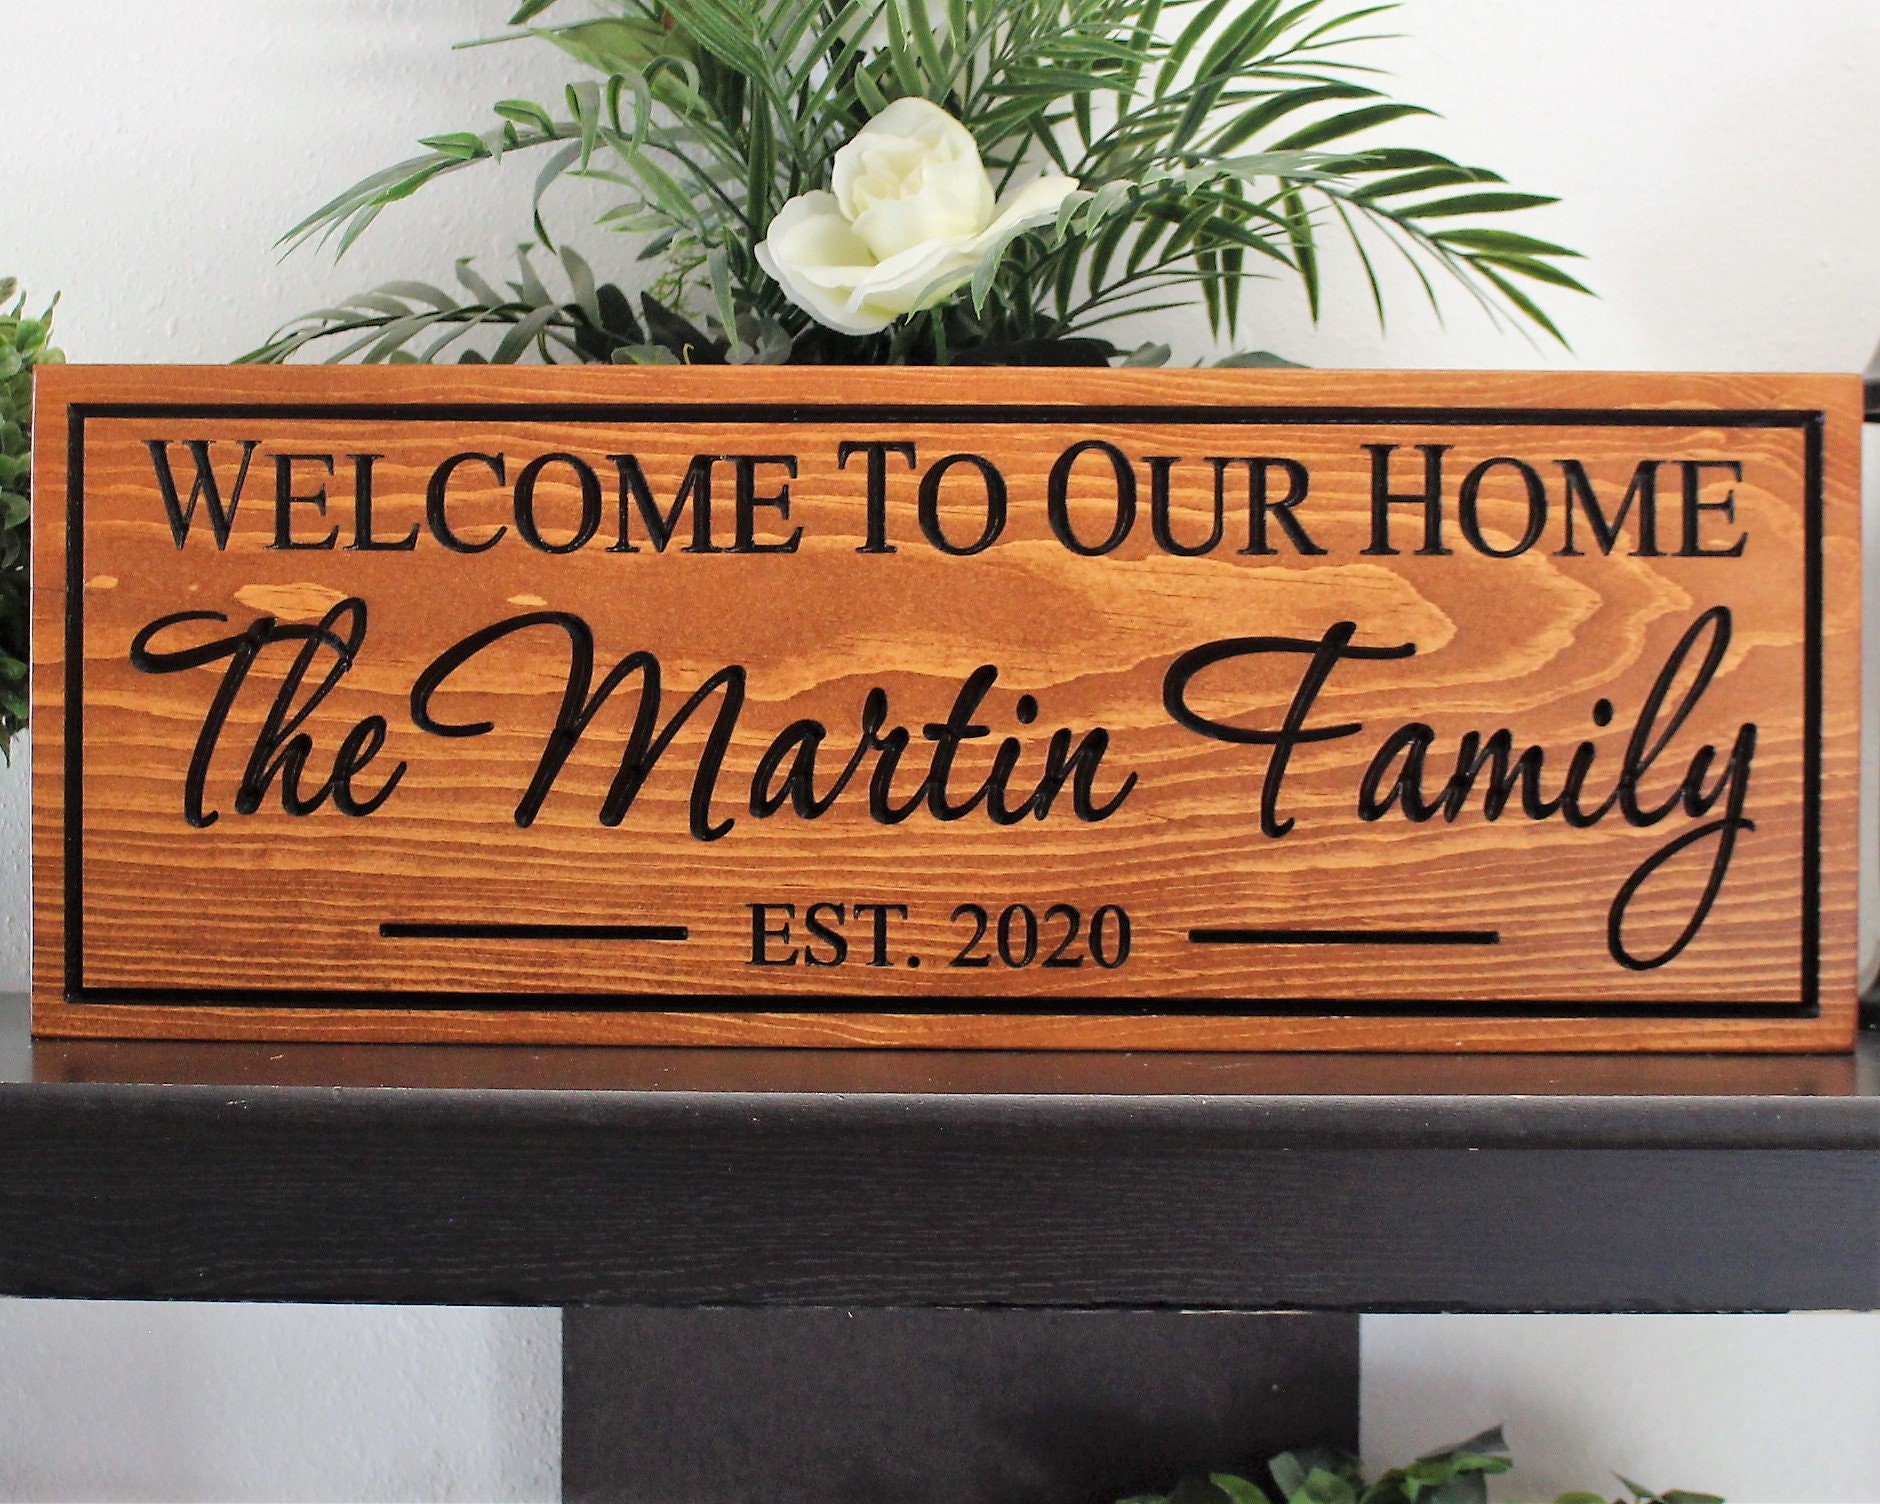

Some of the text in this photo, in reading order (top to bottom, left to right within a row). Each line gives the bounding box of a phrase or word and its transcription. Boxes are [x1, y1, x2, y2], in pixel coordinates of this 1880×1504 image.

[145, 438, 1748, 559] WELCOME TO OUR HOME
[130, 596, 1757, 971] The Martin Family
[745, 903, 1132, 970] EST. 2020
